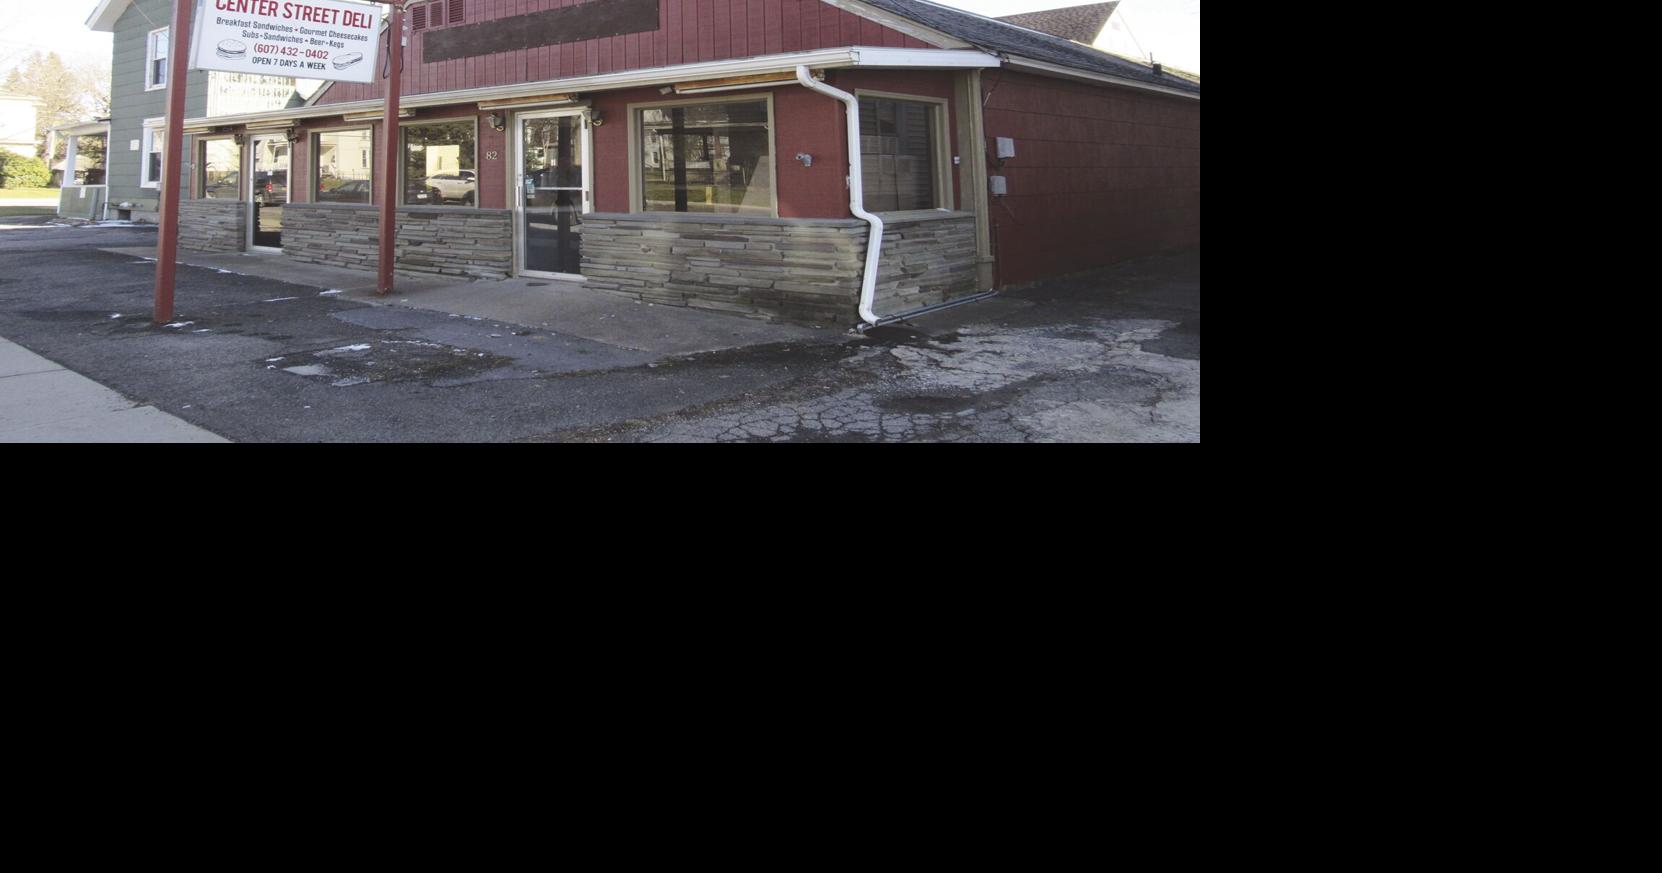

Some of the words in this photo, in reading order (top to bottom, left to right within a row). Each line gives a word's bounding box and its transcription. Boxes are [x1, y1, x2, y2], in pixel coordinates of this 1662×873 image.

[216, 0, 278, 17] CENTER
[282, 2, 340, 25] STREET
[342, 10, 373, 29] DELI
[216, 16, 251, 28] Breakfast
[253, 21, 293, 33] Sandwiches
[299, 27, 327, 36] Gourmet
[329, 30, 368, 42] Cheesecakes
[253, 42, 279, 55] (607)
[252, 56, 272, 66] OPEN
[273, 58, 278, 66] 7
[279, 59, 298, 68] DAYS
[299, 61, 305, 69] A
[306, 61, 326, 70] WEEK
[486, 150, 498, 160] 82
